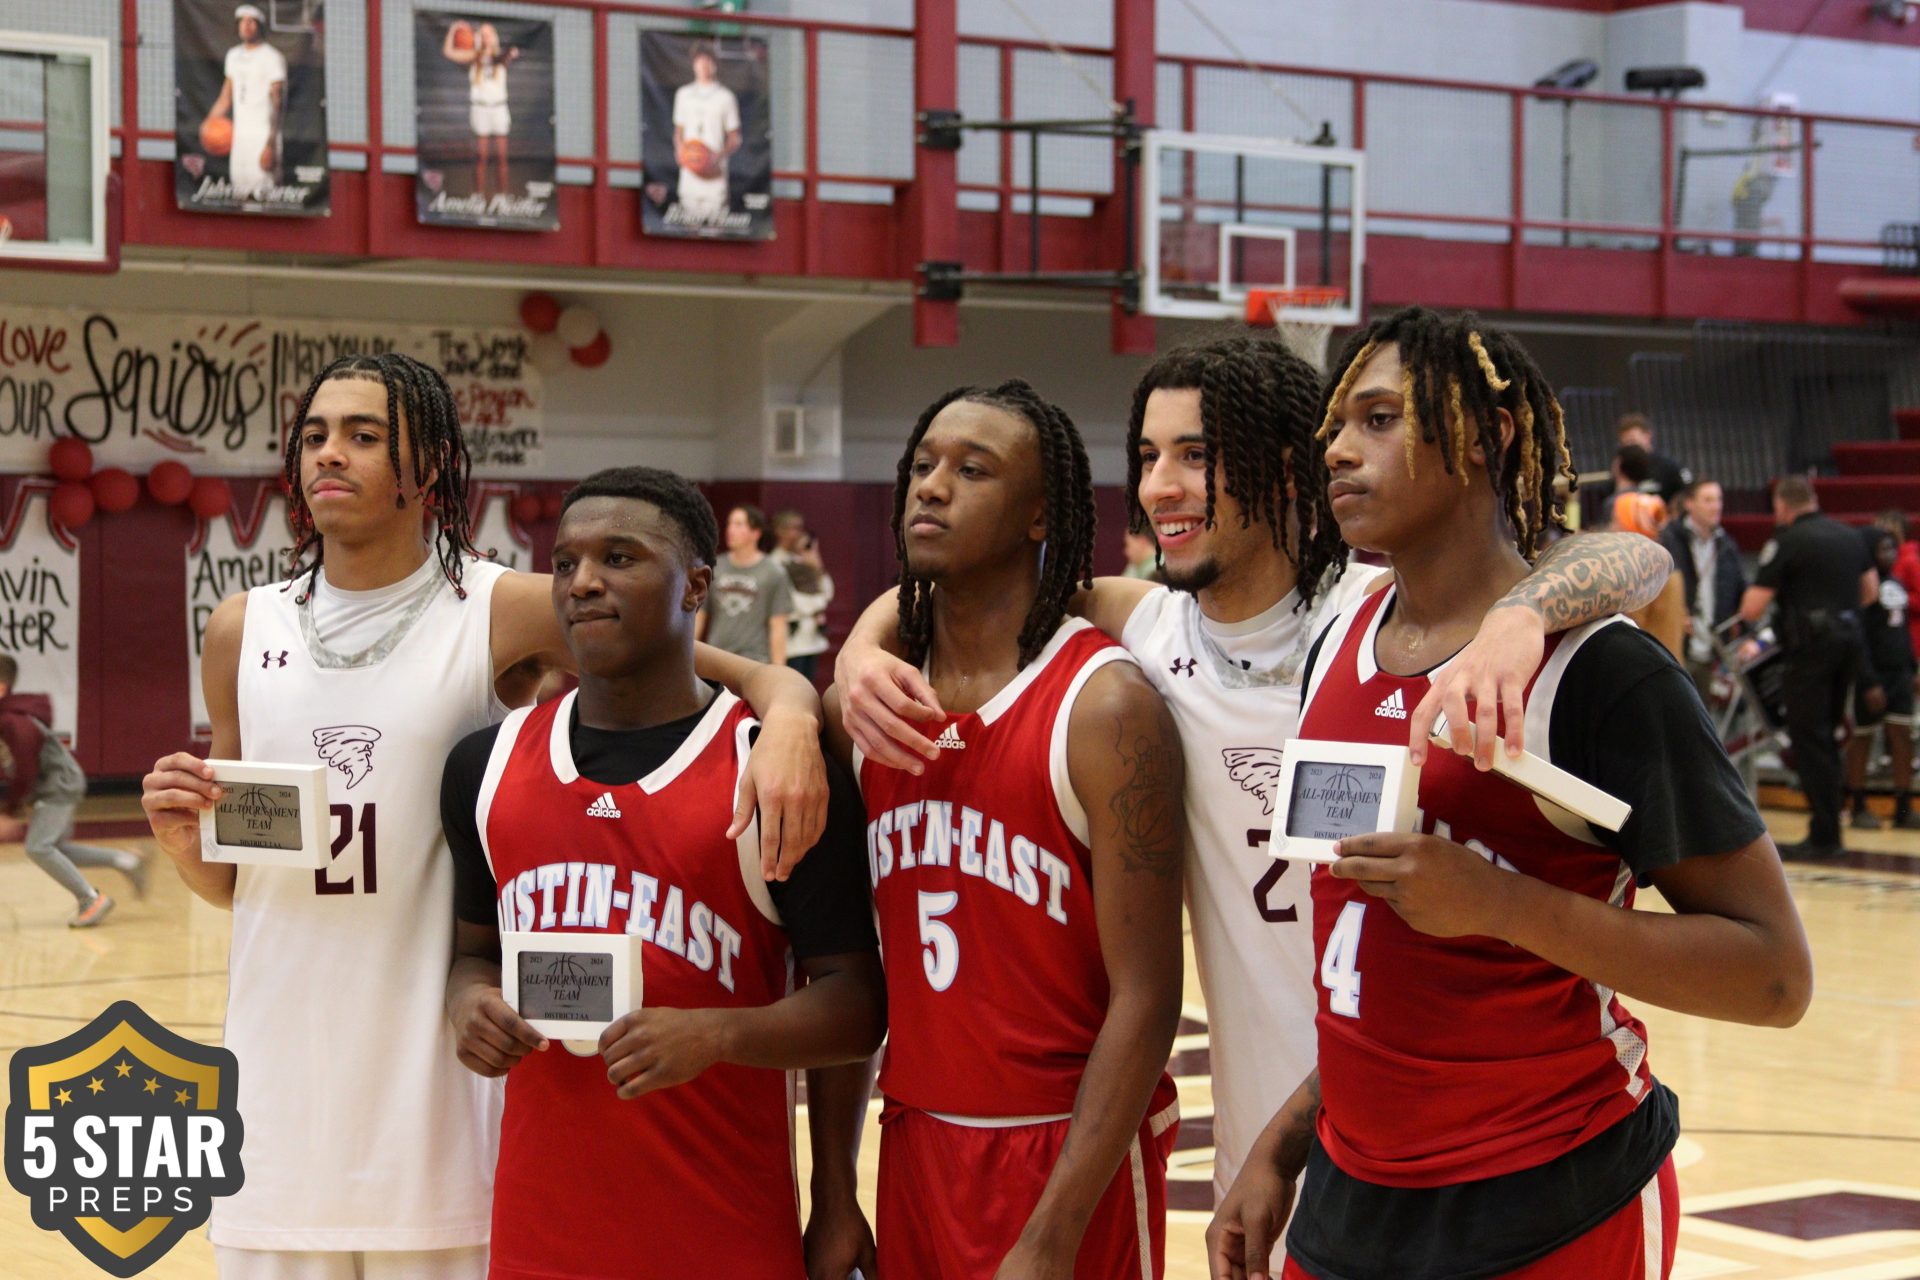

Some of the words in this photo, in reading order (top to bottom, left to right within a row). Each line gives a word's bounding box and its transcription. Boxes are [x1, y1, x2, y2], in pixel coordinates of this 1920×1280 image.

[65, 314, 279, 450] Seniors!
[1375, 705, 1407, 720] adidas
[934, 738, 966, 750] adidas
[219, 803, 299, 818] ALL-TOURNAMENT
[586, 806, 621, 819] adidas
[1326, 806, 1354, 820] TEAM
[247, 819, 272, 831] TEAM
[315, 803, 377, 895] 21
[918, 889, 959, 992] 5
[1320, 900, 1367, 1019] 4
[522, 974, 611, 987] ALL-TOURNAMENT
[553, 989, 580, 1001] TEAM
[544, 1012, 574, 1020] DISTRICT
